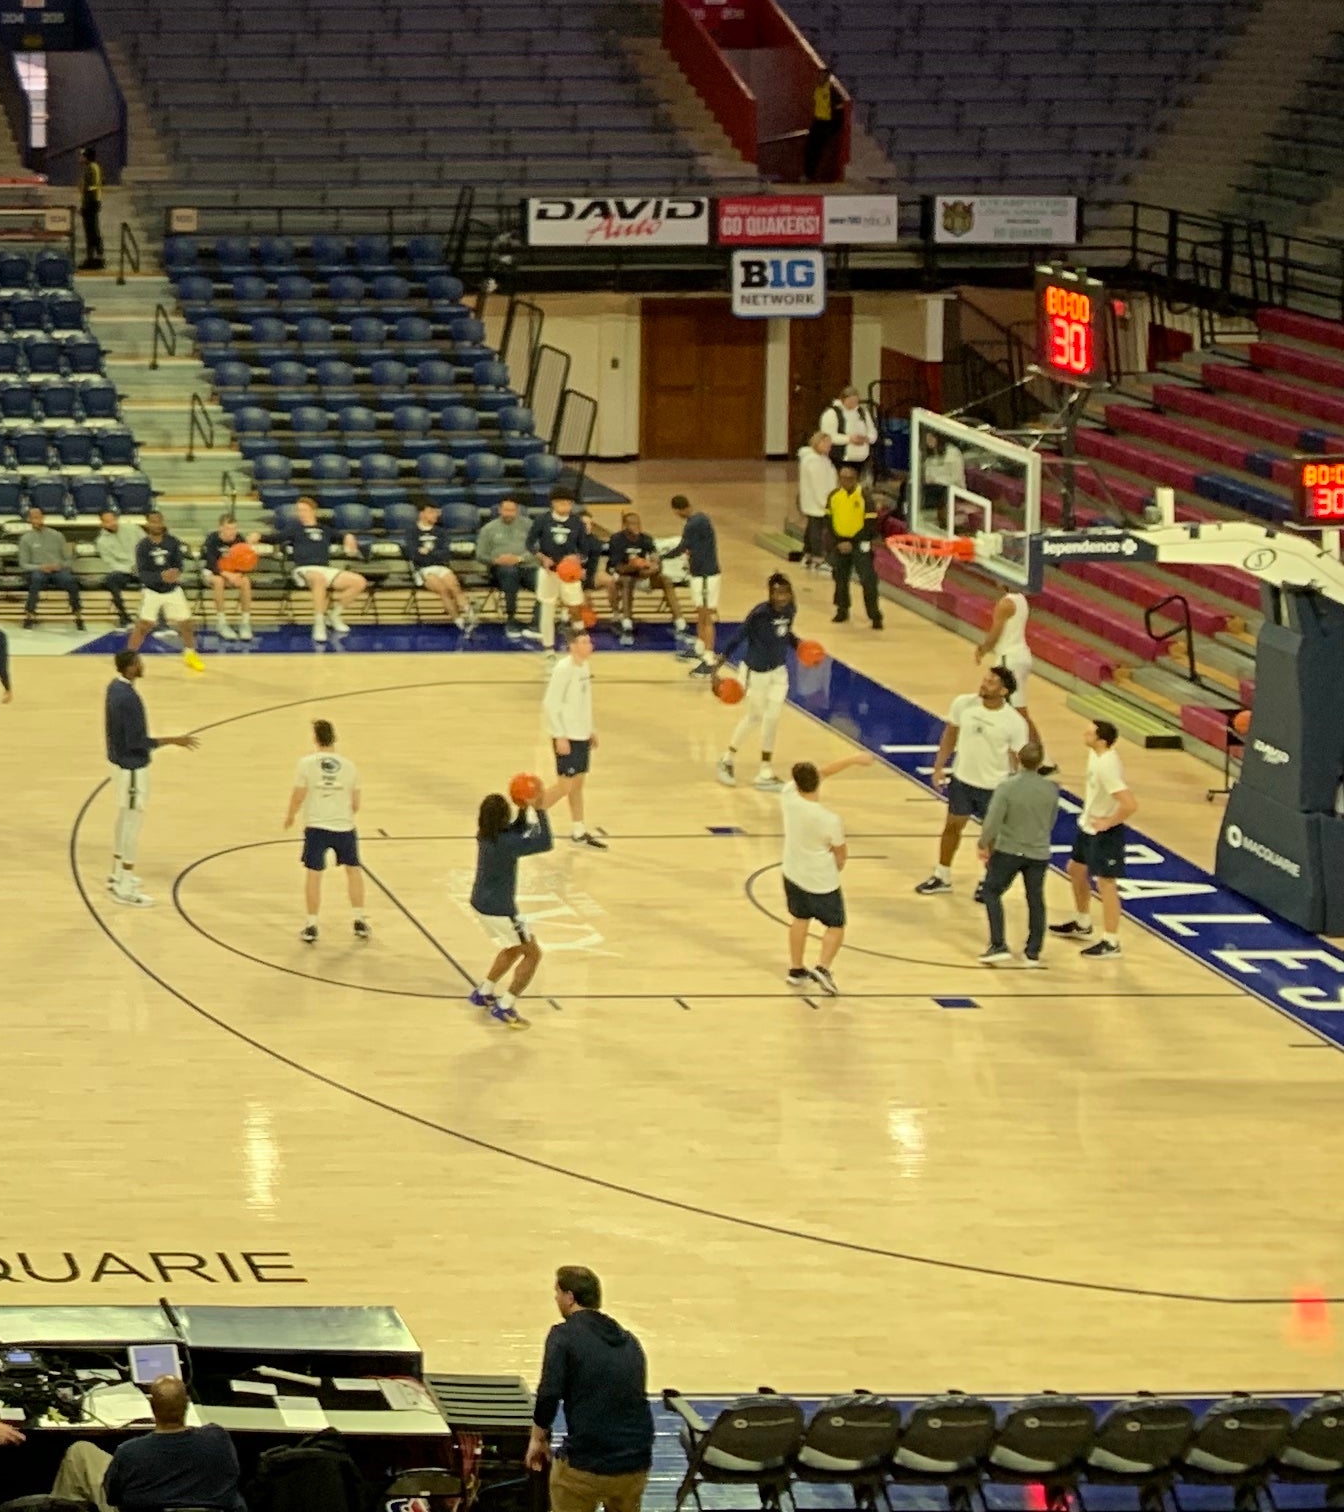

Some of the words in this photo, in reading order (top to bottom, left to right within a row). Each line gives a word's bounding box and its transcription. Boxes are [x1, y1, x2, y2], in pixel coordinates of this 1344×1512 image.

[535, 199, 705, 220] DAVID
[585, 212, 662, 243] Auto
[721, 216, 742, 236] GO
[745, 215, 820, 236] QUAKERS!
[740, 293, 815, 307] NETWORK
[1053, 321, 1086, 372] 30
